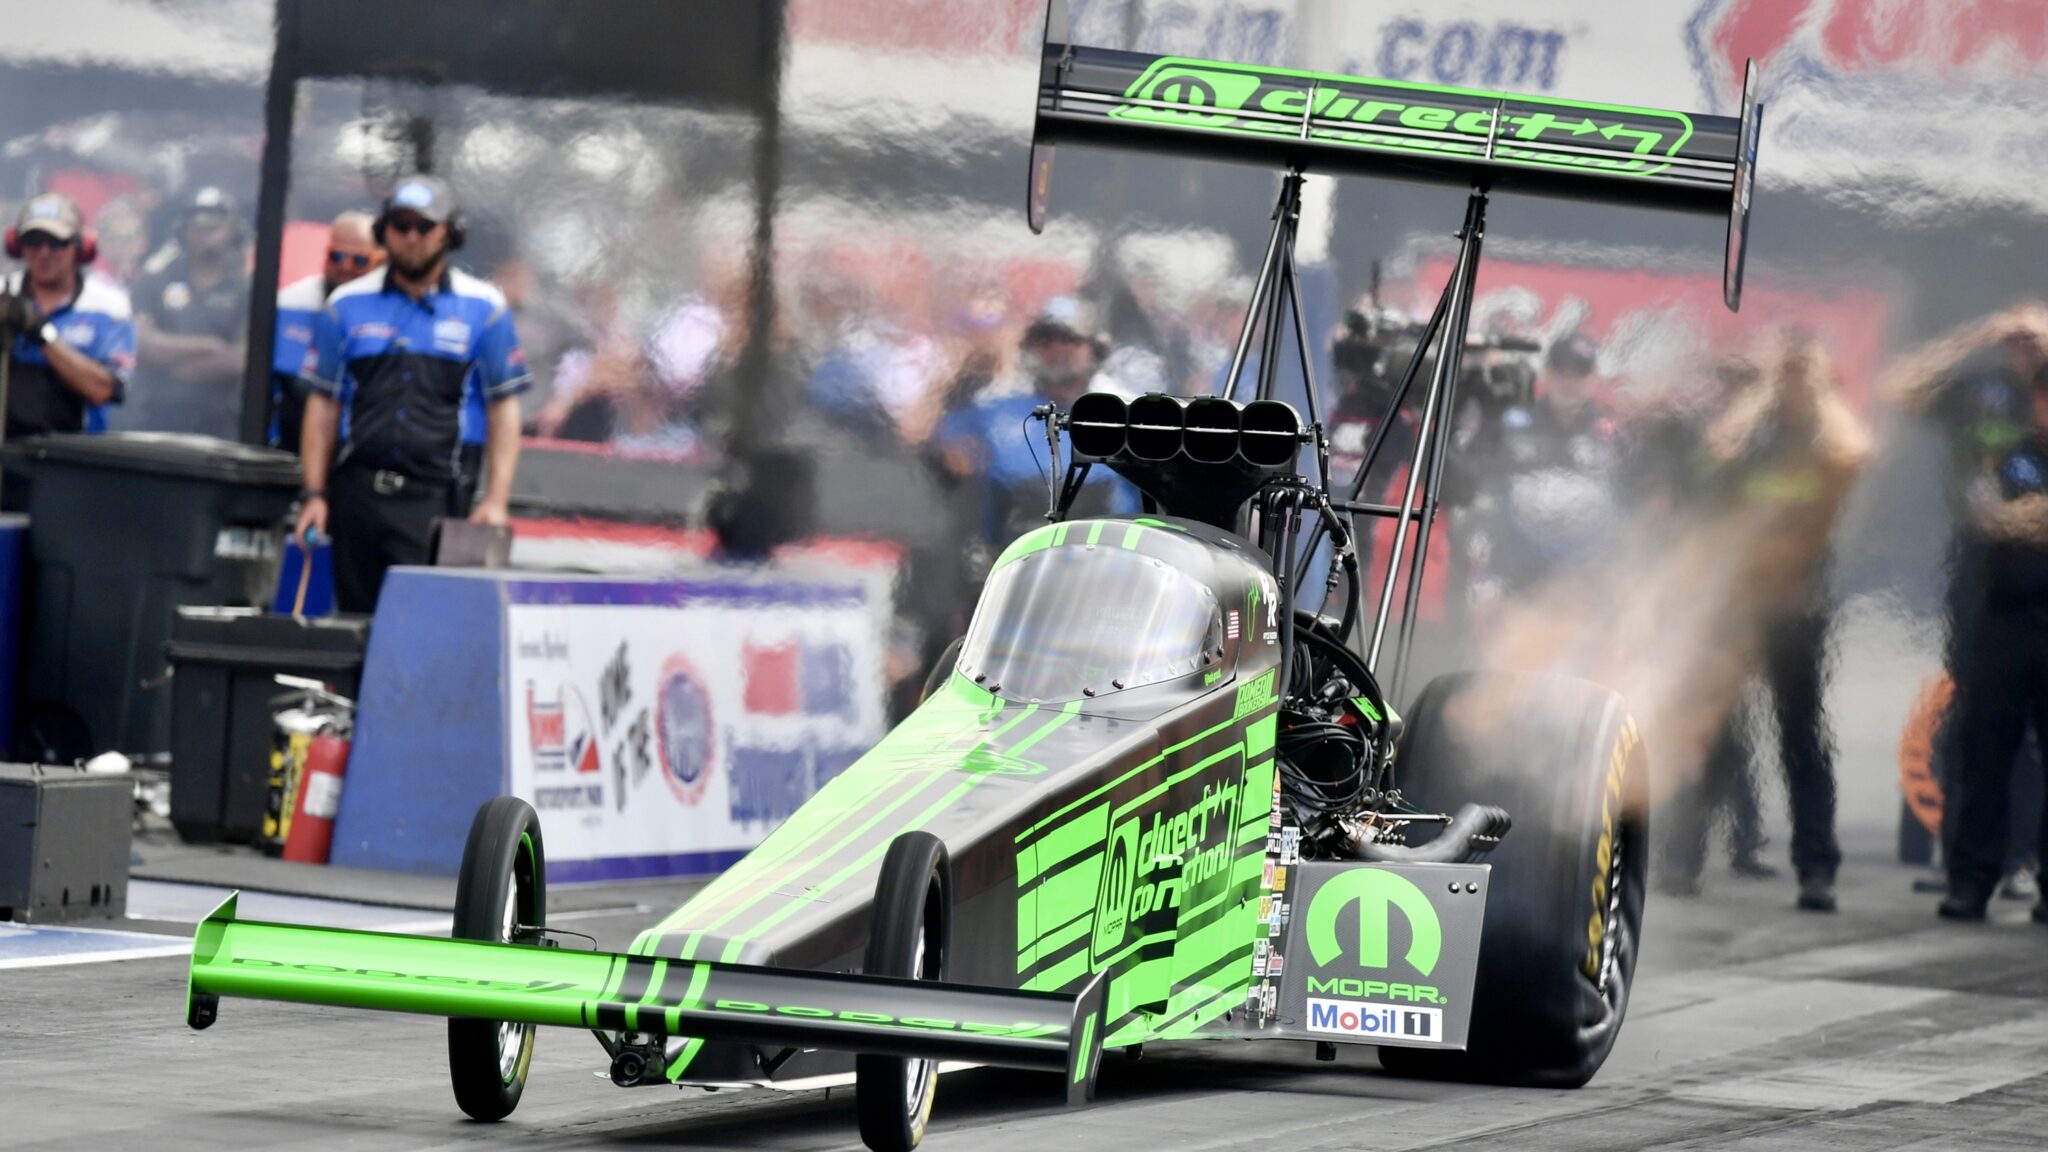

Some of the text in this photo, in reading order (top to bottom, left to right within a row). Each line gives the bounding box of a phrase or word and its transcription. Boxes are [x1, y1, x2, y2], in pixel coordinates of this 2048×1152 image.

[1260, 86, 1558, 141] direct
[715, 999, 1014, 1036] DODGE
[1312, 1003, 1396, 1034] Mobil
